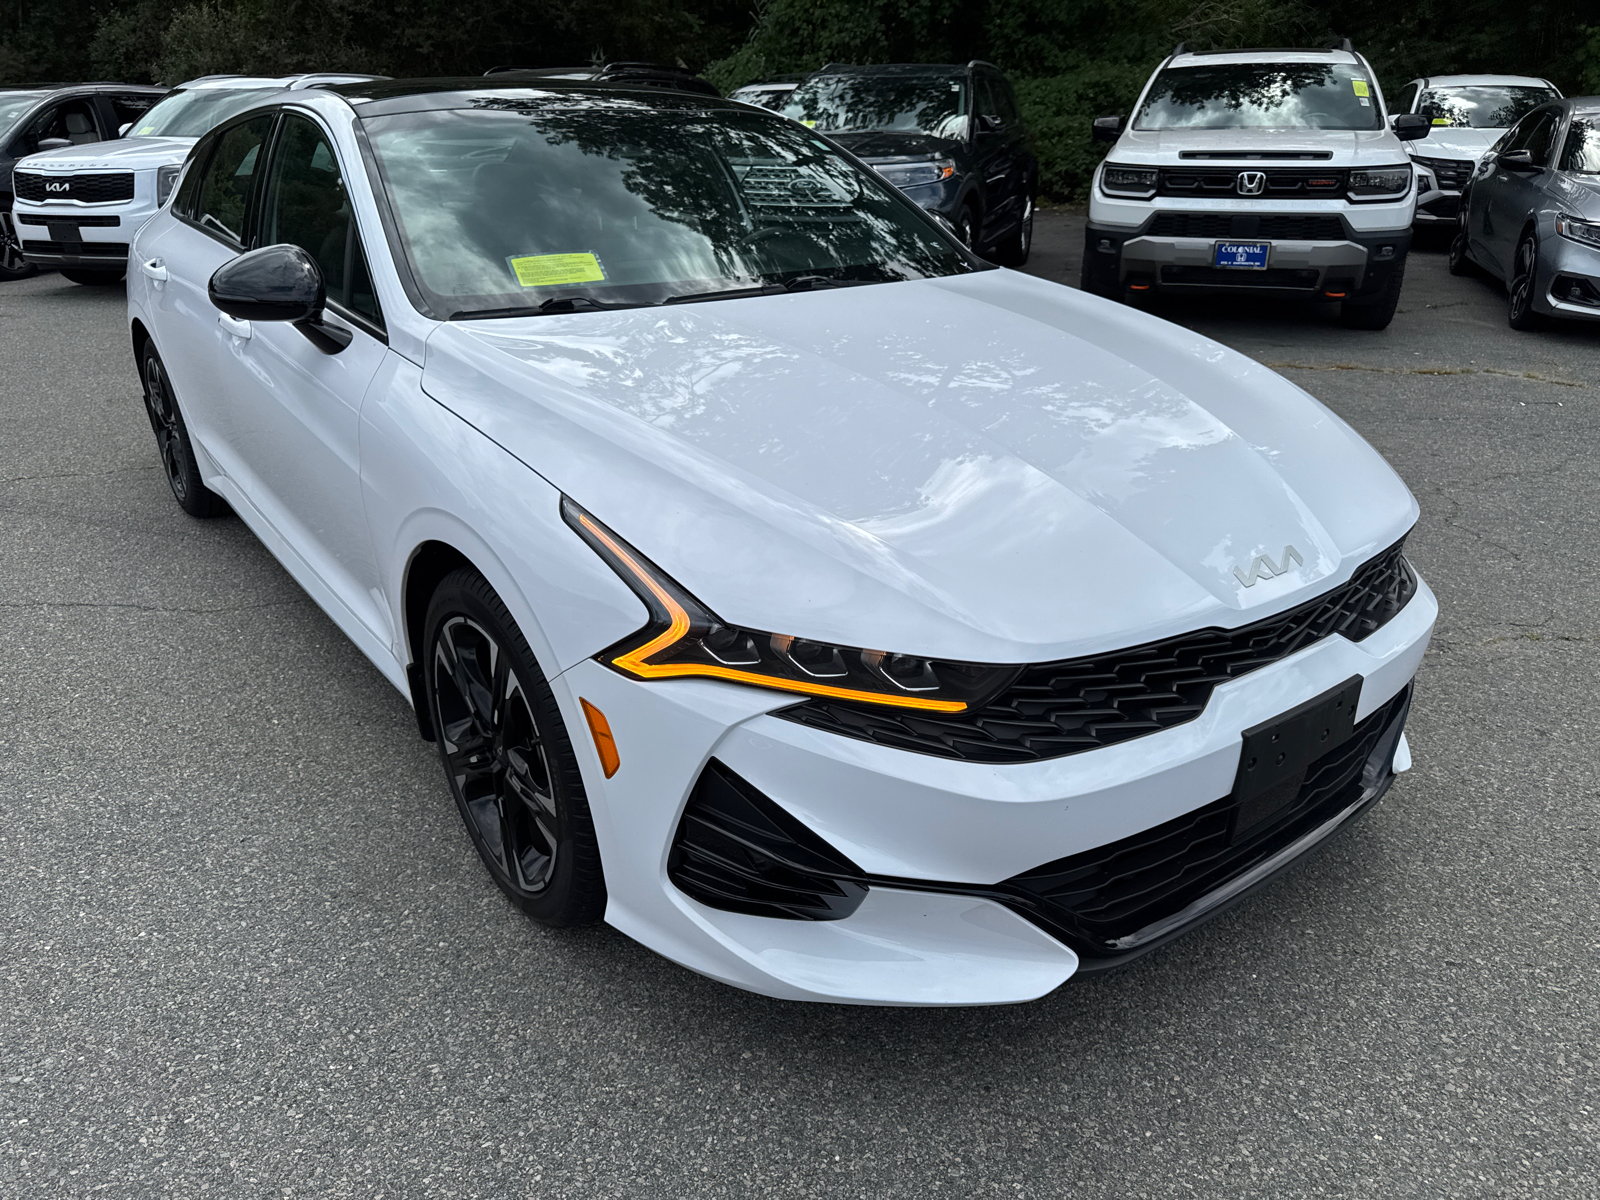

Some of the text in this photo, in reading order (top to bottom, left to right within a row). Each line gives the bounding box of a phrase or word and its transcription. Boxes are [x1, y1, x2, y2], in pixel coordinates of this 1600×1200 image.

[45, 182, 70, 192] KIA
[1221, 245, 1263, 254] COLONIAL
[1232, 544, 1304, 589] KIA
